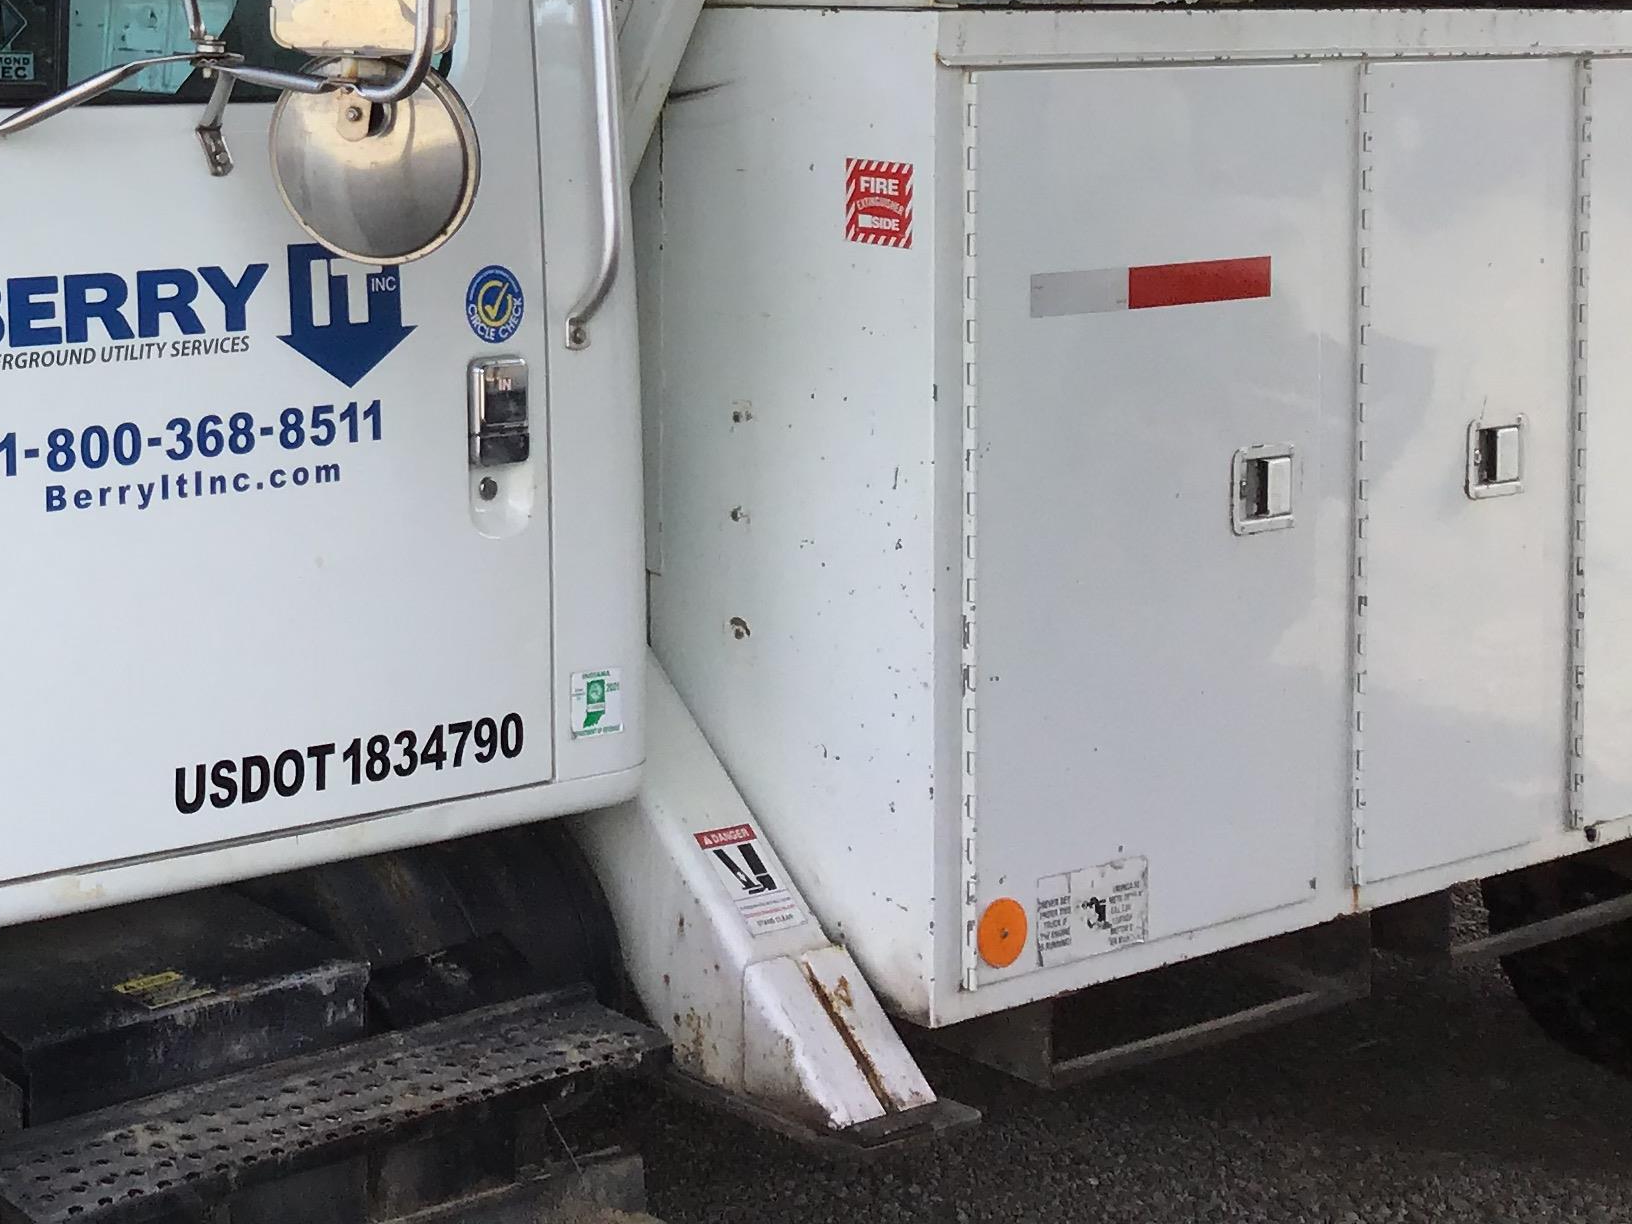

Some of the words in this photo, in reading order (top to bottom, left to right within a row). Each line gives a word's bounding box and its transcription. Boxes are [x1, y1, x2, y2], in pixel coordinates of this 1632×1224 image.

[859, 175, 900, 196] FIRE
[371, 276, 397, 292] INC
[468, 303, 496, 341] CIRCLE
[498, 297, 523, 339] CHECK
[100, 341, 169, 364] UTILITY
[170, 335, 250, 358] SERVICES
[45, 462, 341, 512] BerryItInc.com
[175, 743, 335, 814] USDOT
[342, 712, 524, 786] 1834790
[712, 827, 750, 844] DANGER
